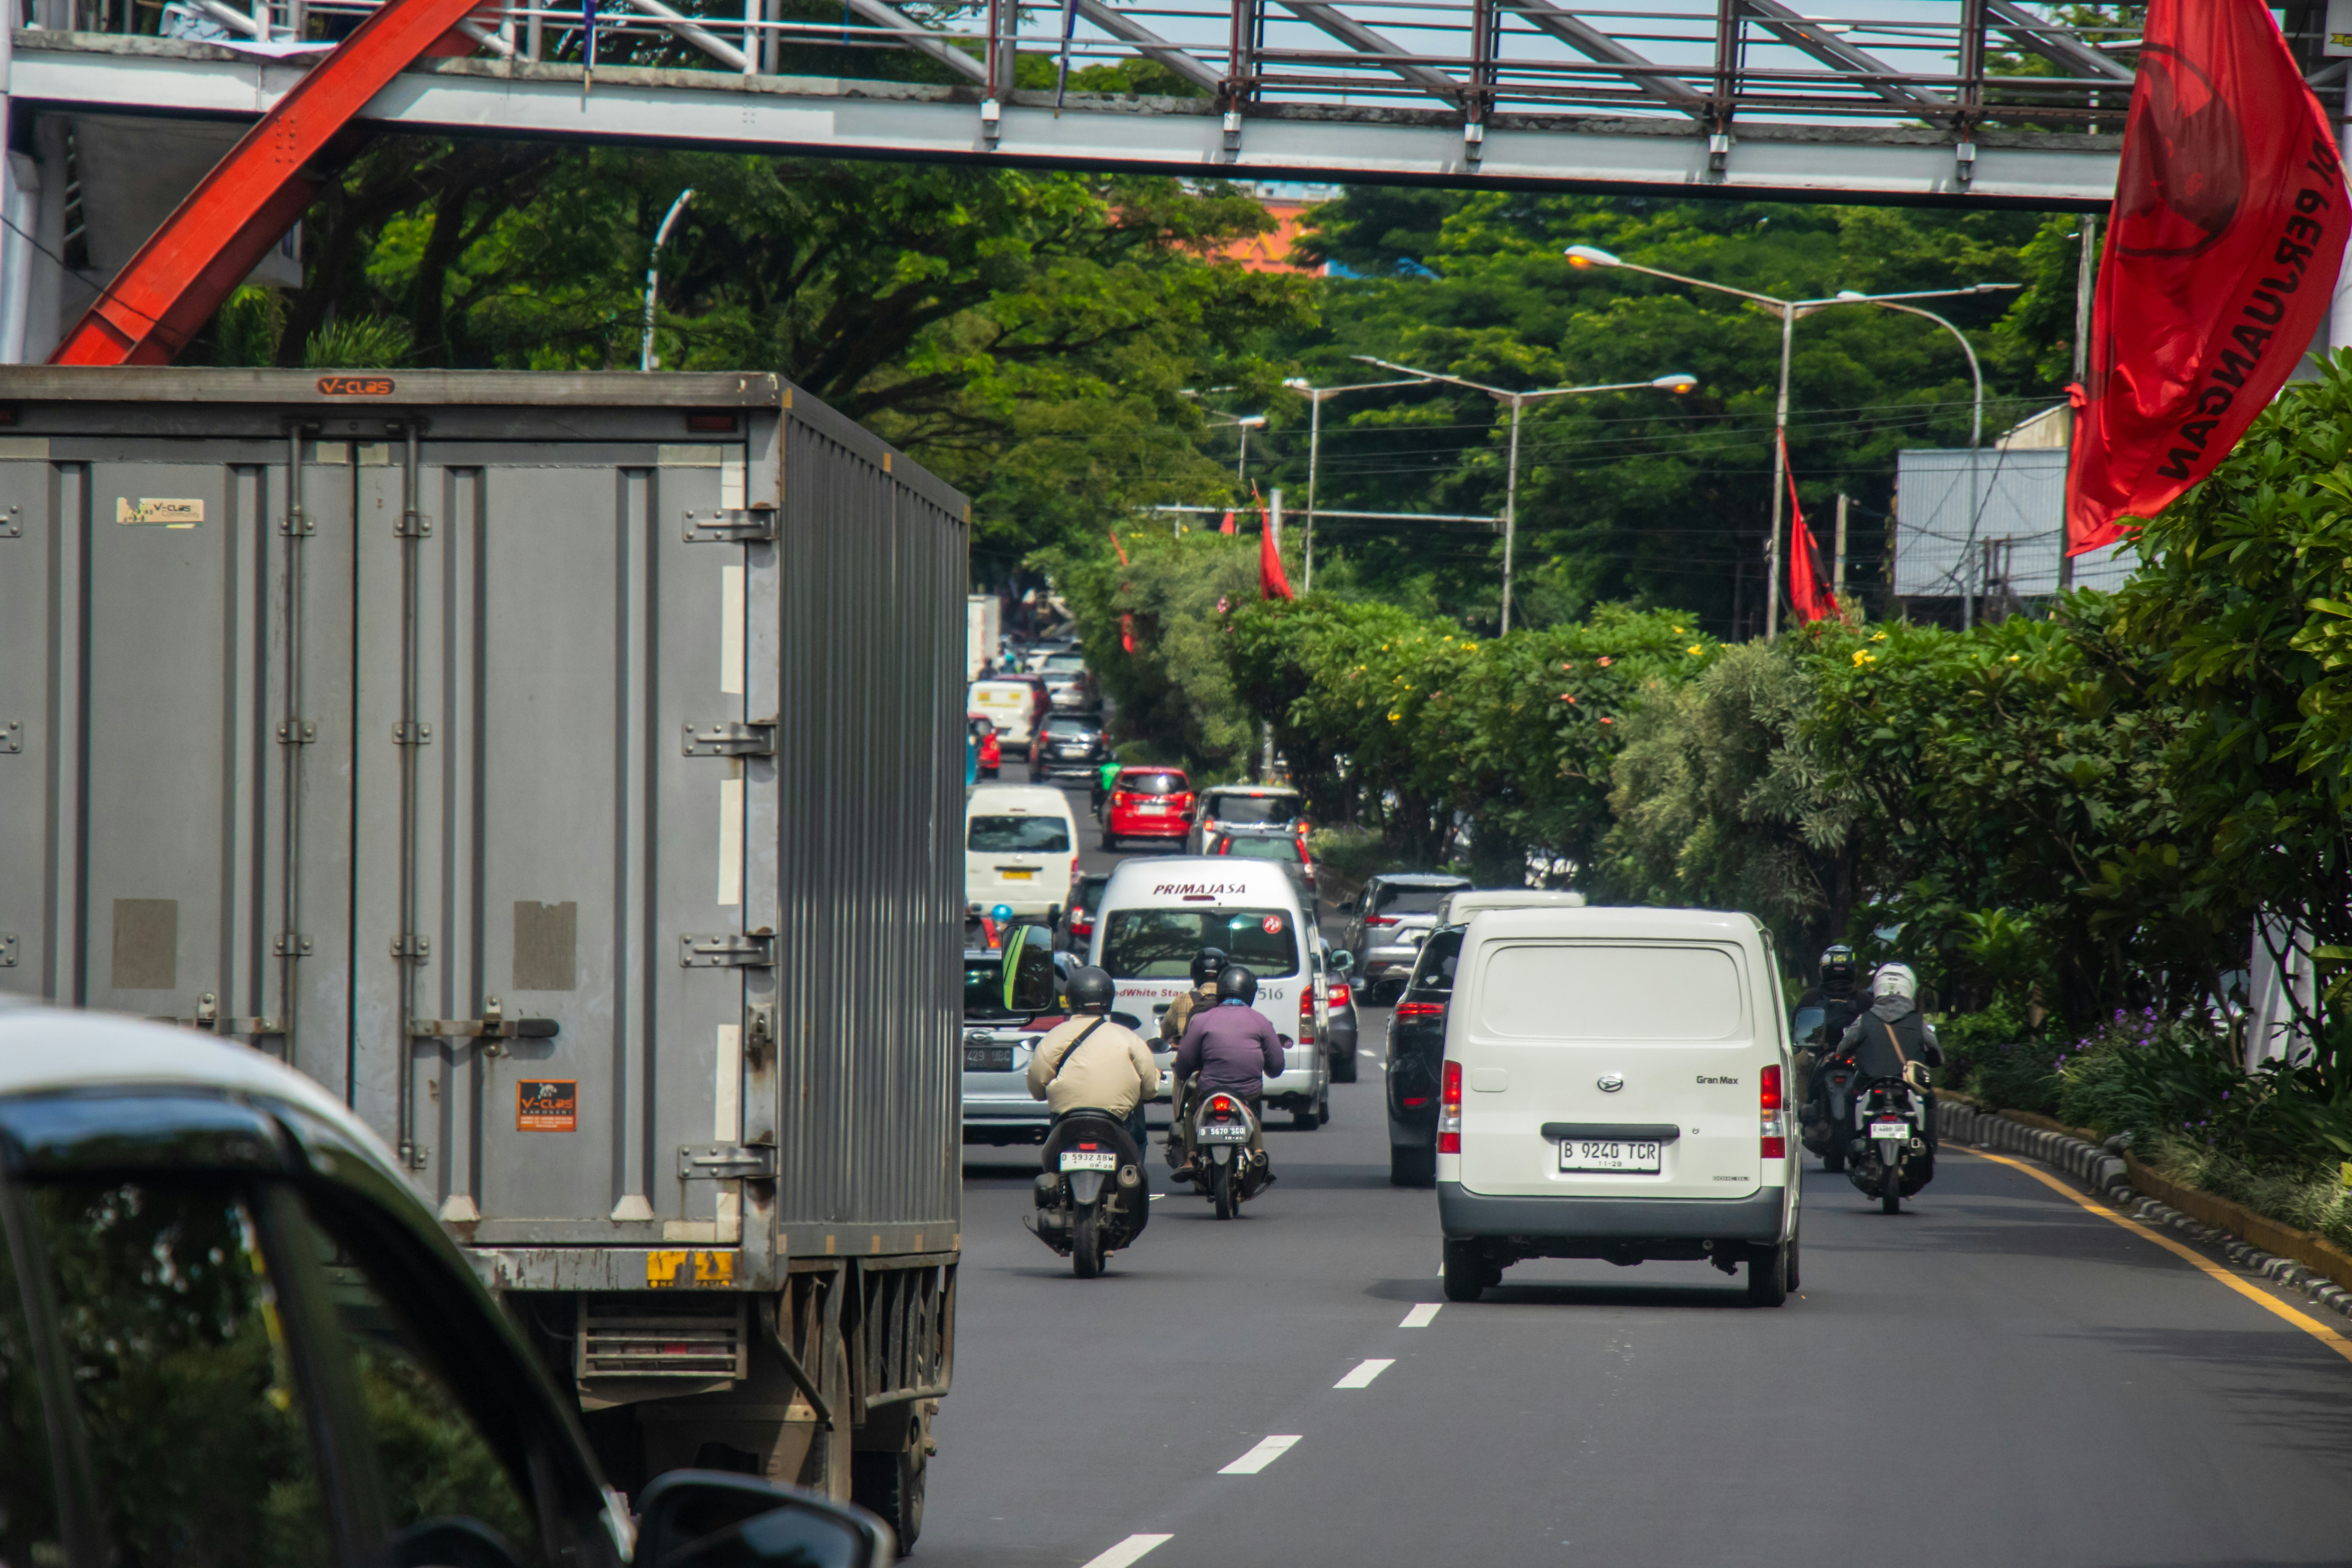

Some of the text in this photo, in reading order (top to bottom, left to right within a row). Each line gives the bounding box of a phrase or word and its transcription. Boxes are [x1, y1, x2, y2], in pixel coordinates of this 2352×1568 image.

[1153, 884, 1246, 895] PRIMAJASA
[1565, 1142, 1655, 1159] B 9240 TCR
